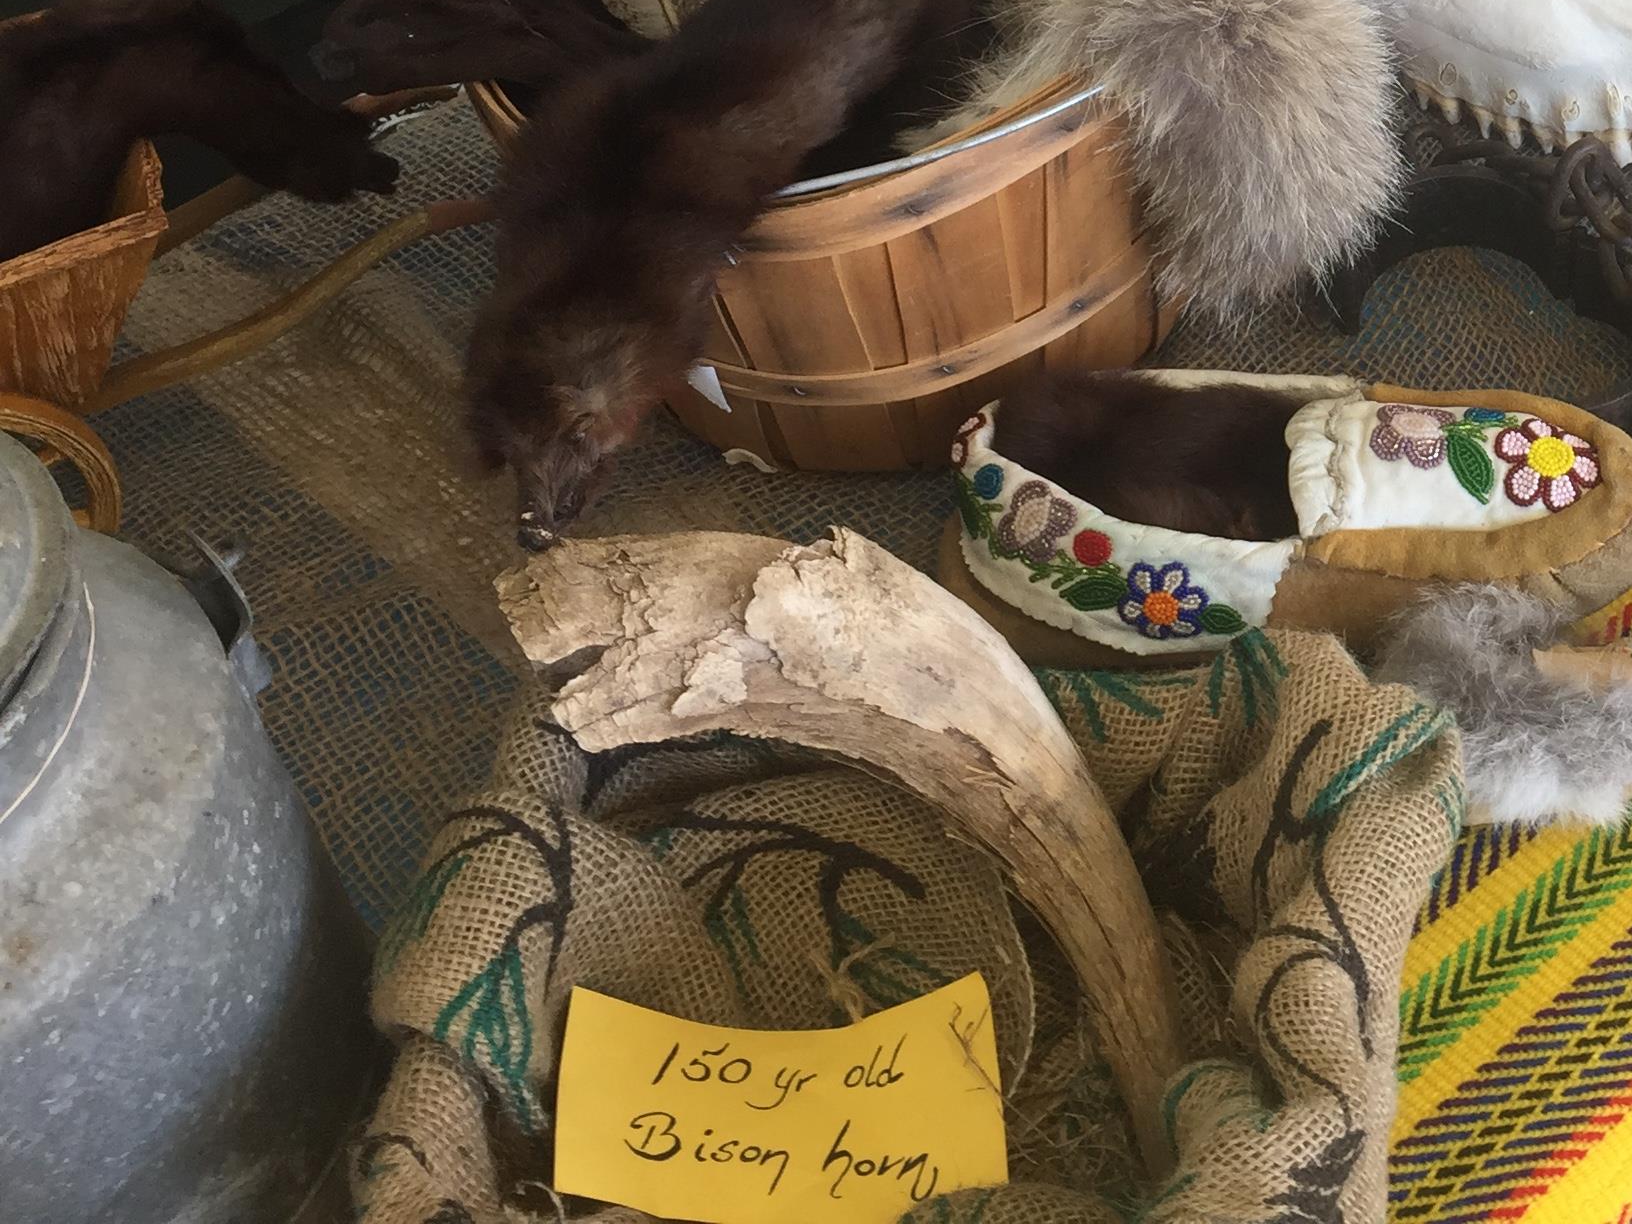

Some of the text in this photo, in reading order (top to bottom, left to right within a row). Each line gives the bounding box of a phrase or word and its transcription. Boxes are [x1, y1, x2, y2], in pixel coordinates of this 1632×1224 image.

[651, 1032, 906, 1111] 150 yr old
[623, 1111, 790, 1197] Bison
